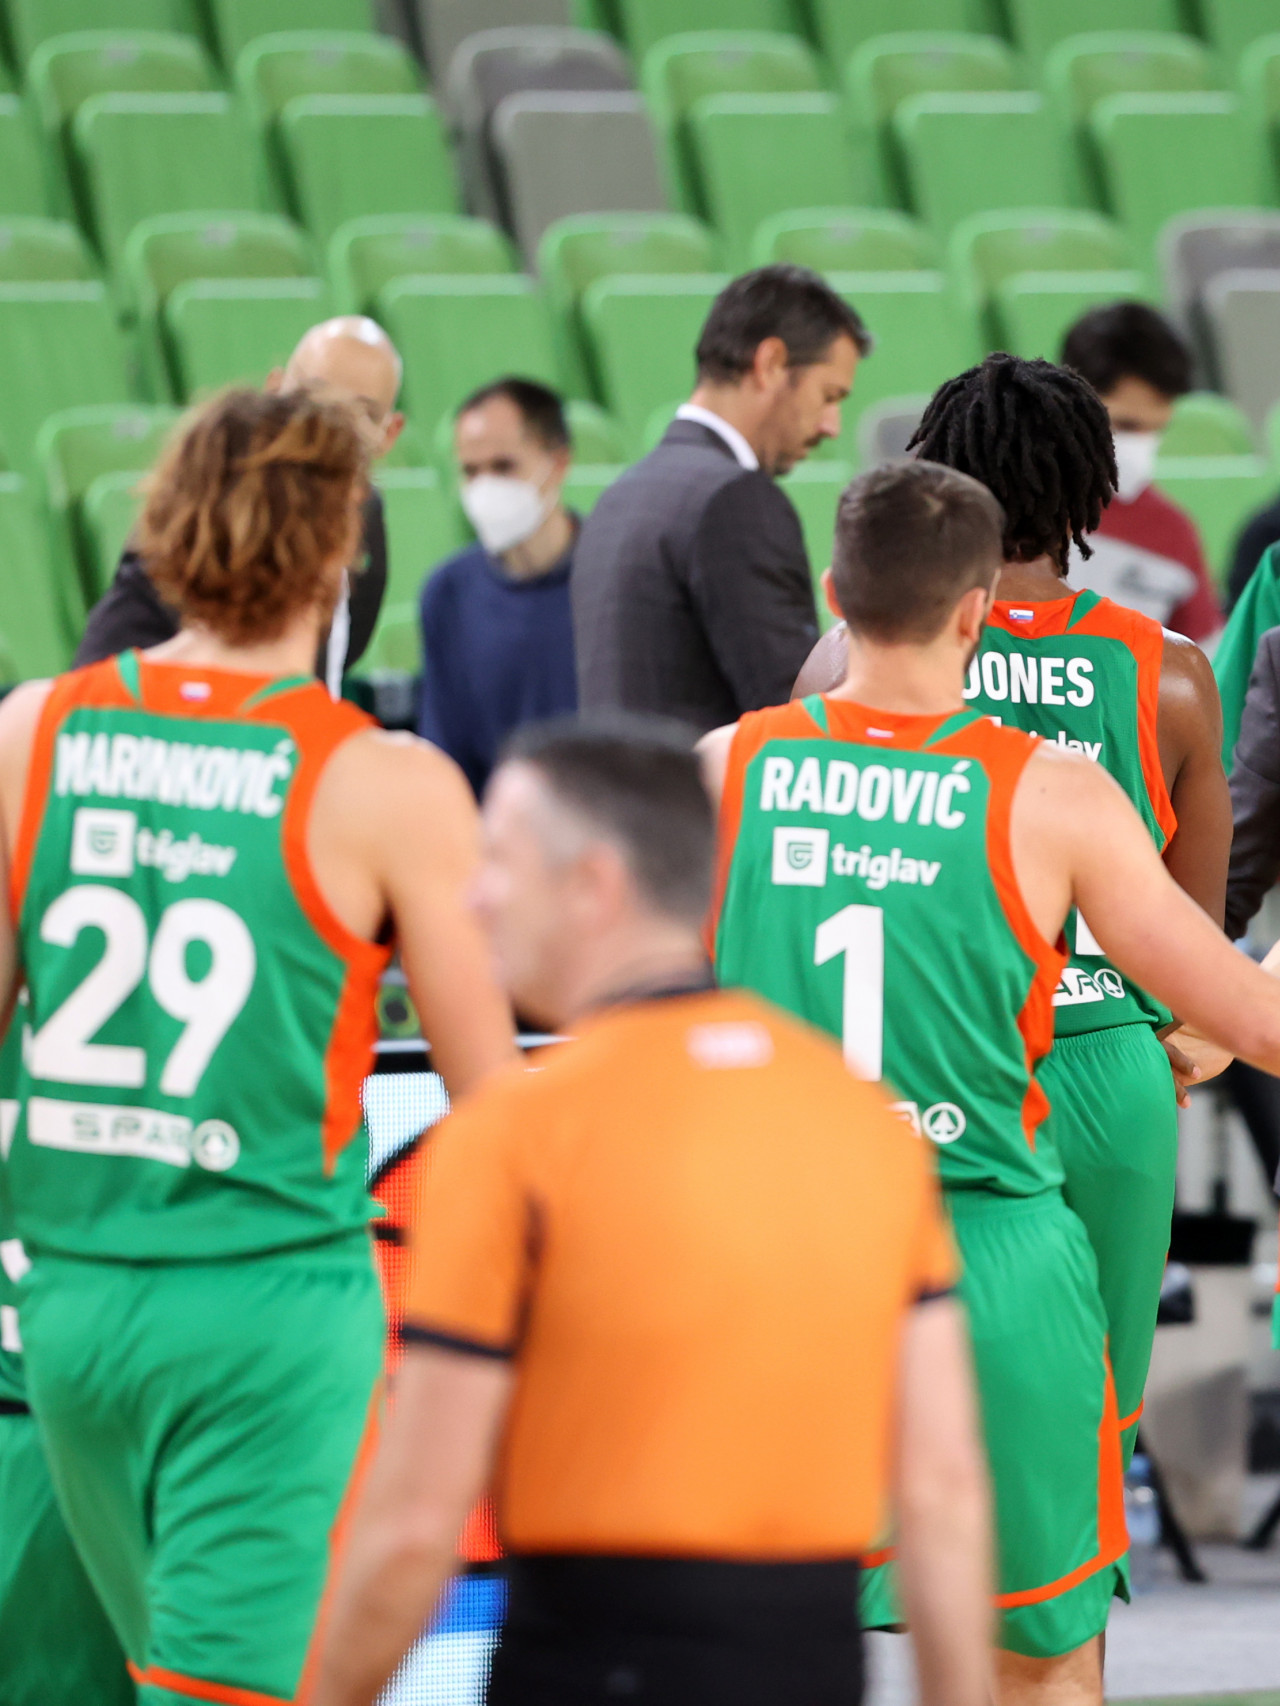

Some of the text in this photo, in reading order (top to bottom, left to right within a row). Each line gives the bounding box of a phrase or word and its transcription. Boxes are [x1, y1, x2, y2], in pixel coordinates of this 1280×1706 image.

[961, 651, 1095, 707] JONES
[55, 732, 297, 818] MARINKOVIĆ
[760, 757, 972, 829] RADOVIĆ
[137, 829, 235, 881] triglav
[832, 842, 941, 890] triglav
[29, 884, 257, 1098] 29
[814, 904, 884, 1082] 1
